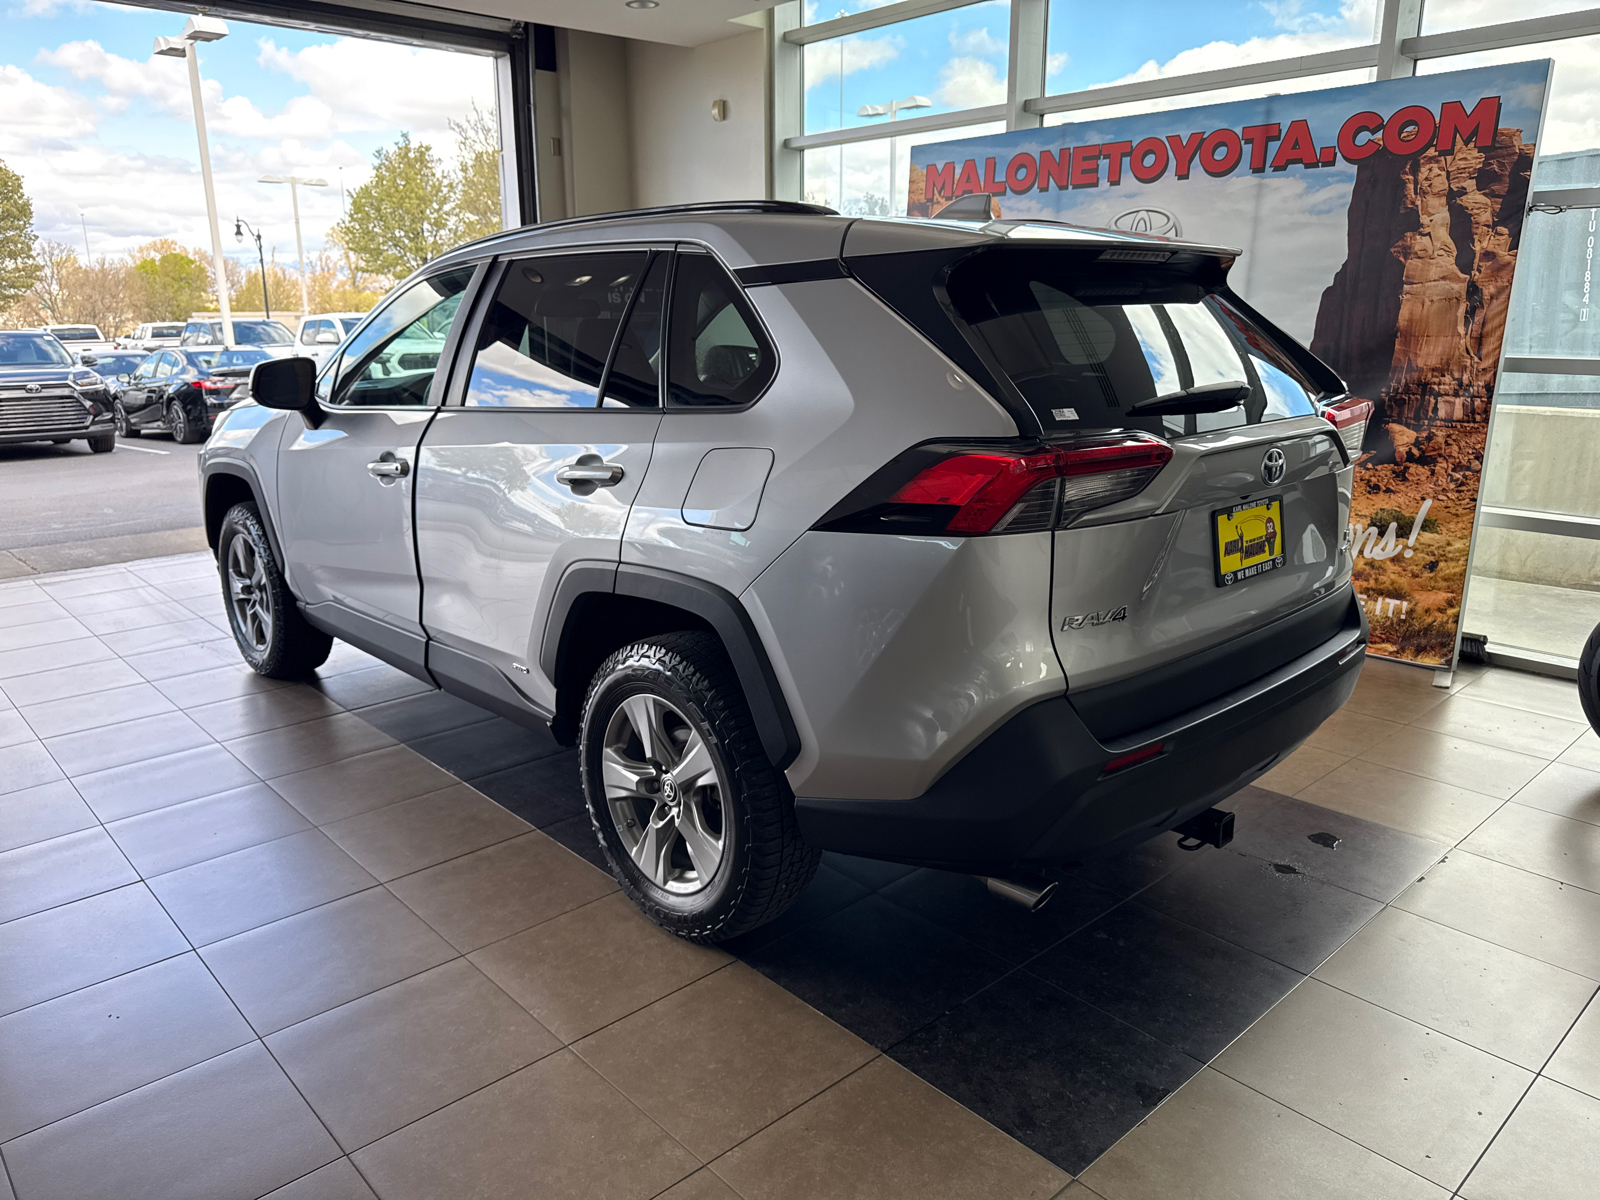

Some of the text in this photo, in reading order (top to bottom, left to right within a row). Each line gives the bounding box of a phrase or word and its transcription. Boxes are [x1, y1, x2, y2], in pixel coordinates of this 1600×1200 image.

[925, 96, 1502, 200] MALONETOYOTA.COM
[1266, 522, 1274, 533] 32
[1236, 571, 1245, 580] WE
[1245, 566, 1257, 578] MAKE
[1262, 560, 1273, 572] EASY
[1061, 605, 1128, 632] RAV4
